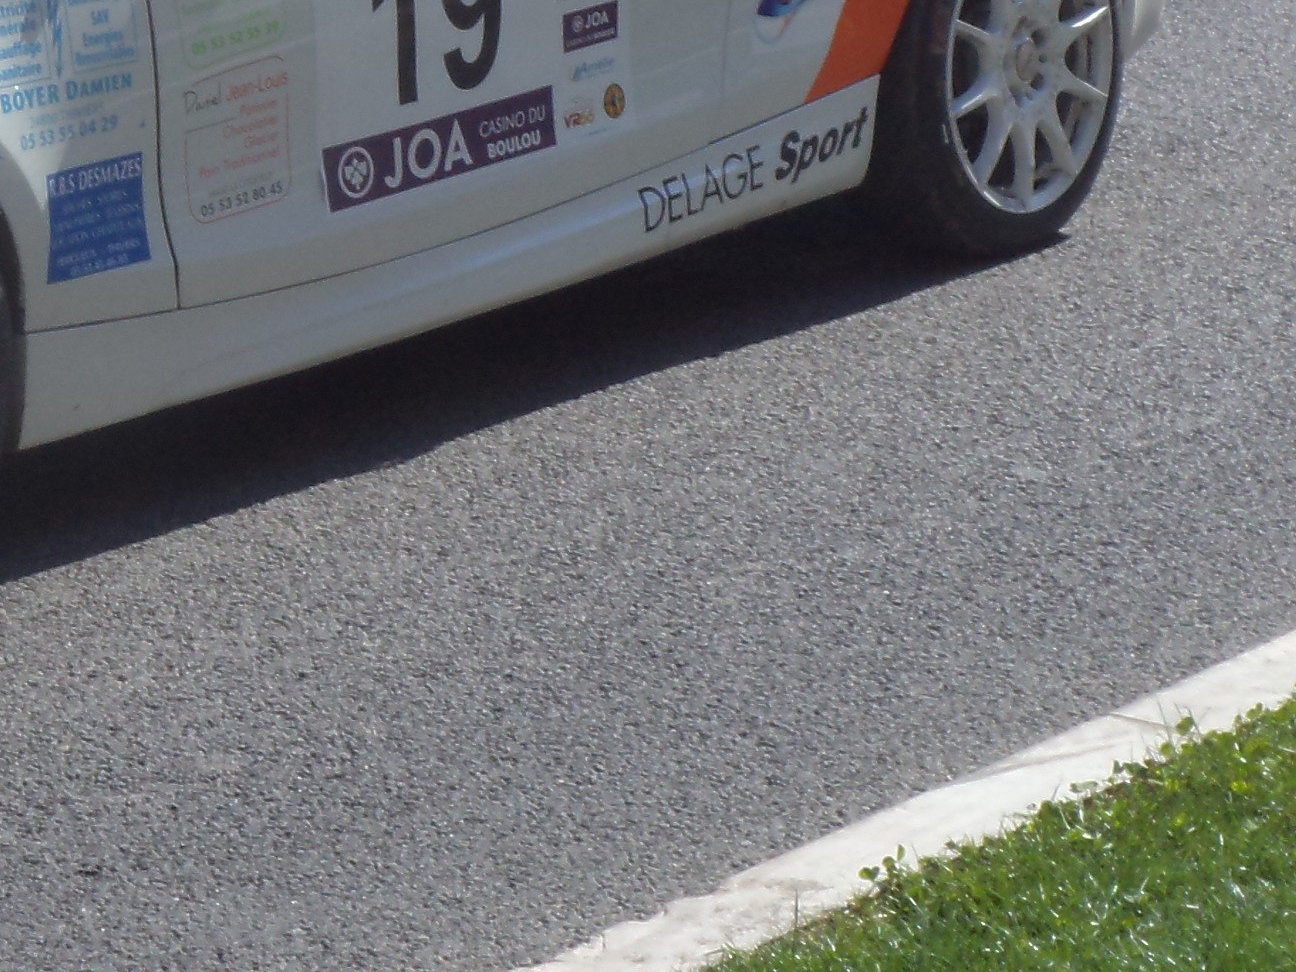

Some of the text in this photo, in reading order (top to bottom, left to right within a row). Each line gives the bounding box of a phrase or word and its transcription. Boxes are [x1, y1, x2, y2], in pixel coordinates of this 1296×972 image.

[585, 10, 610, 30] JOA
[0, 83, 60, 115] BOYER
[65, 73, 133, 101] DAMIEN
[384, 104, 546, 190] JOA CASINO DU
[486, 129, 542, 160] BOULOU
[638, 106, 870, 234] DELAGE Sport
[200, 202, 215, 218] 05
[218, 196, 233, 211] 53
[235, 191, 250, 207] 52
[252, 185, 267, 201] 80
[269, 180, 284, 195] 45
